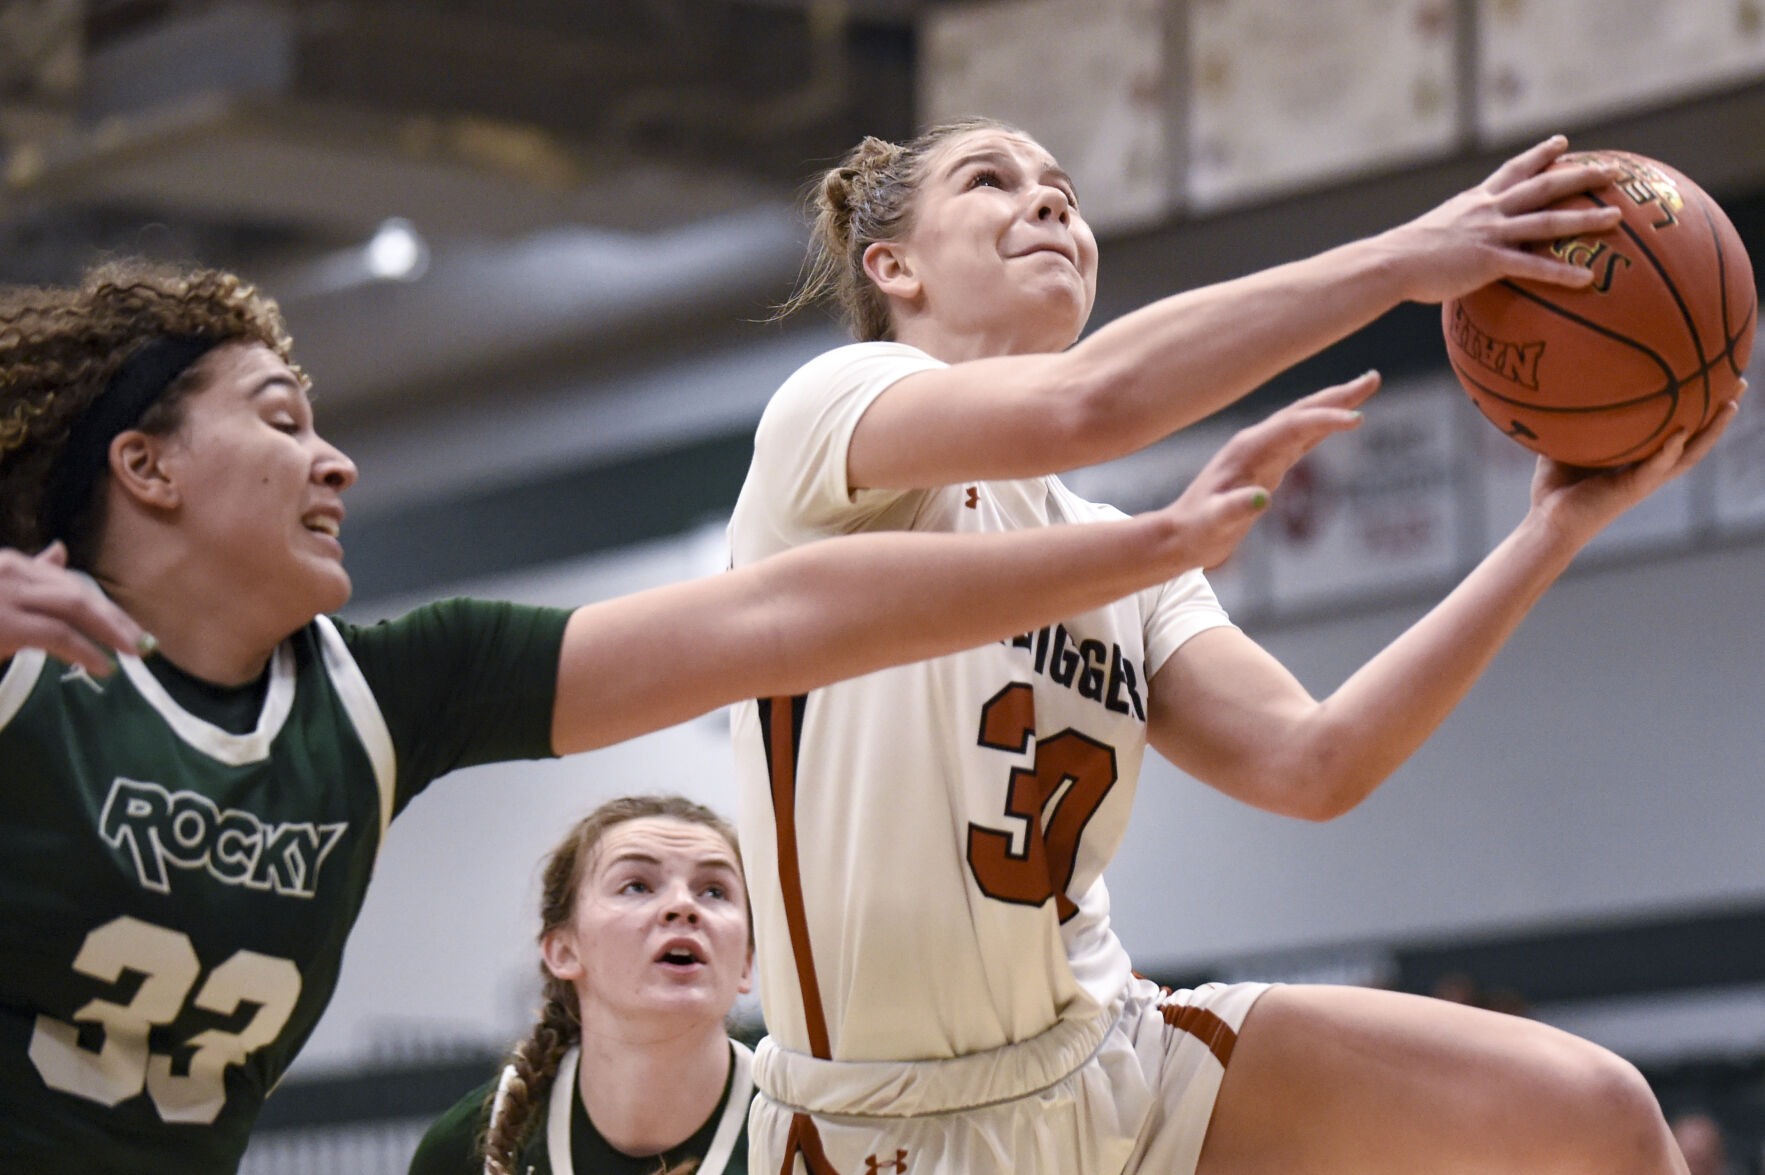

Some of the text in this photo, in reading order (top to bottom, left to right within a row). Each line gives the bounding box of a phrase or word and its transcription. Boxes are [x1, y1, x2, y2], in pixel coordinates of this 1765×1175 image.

[1012, 623, 1148, 722] IGGER
[100, 776, 349, 899] ROCKY
[967, 681, 1118, 926] 30
[27, 915, 302, 1126] 33
